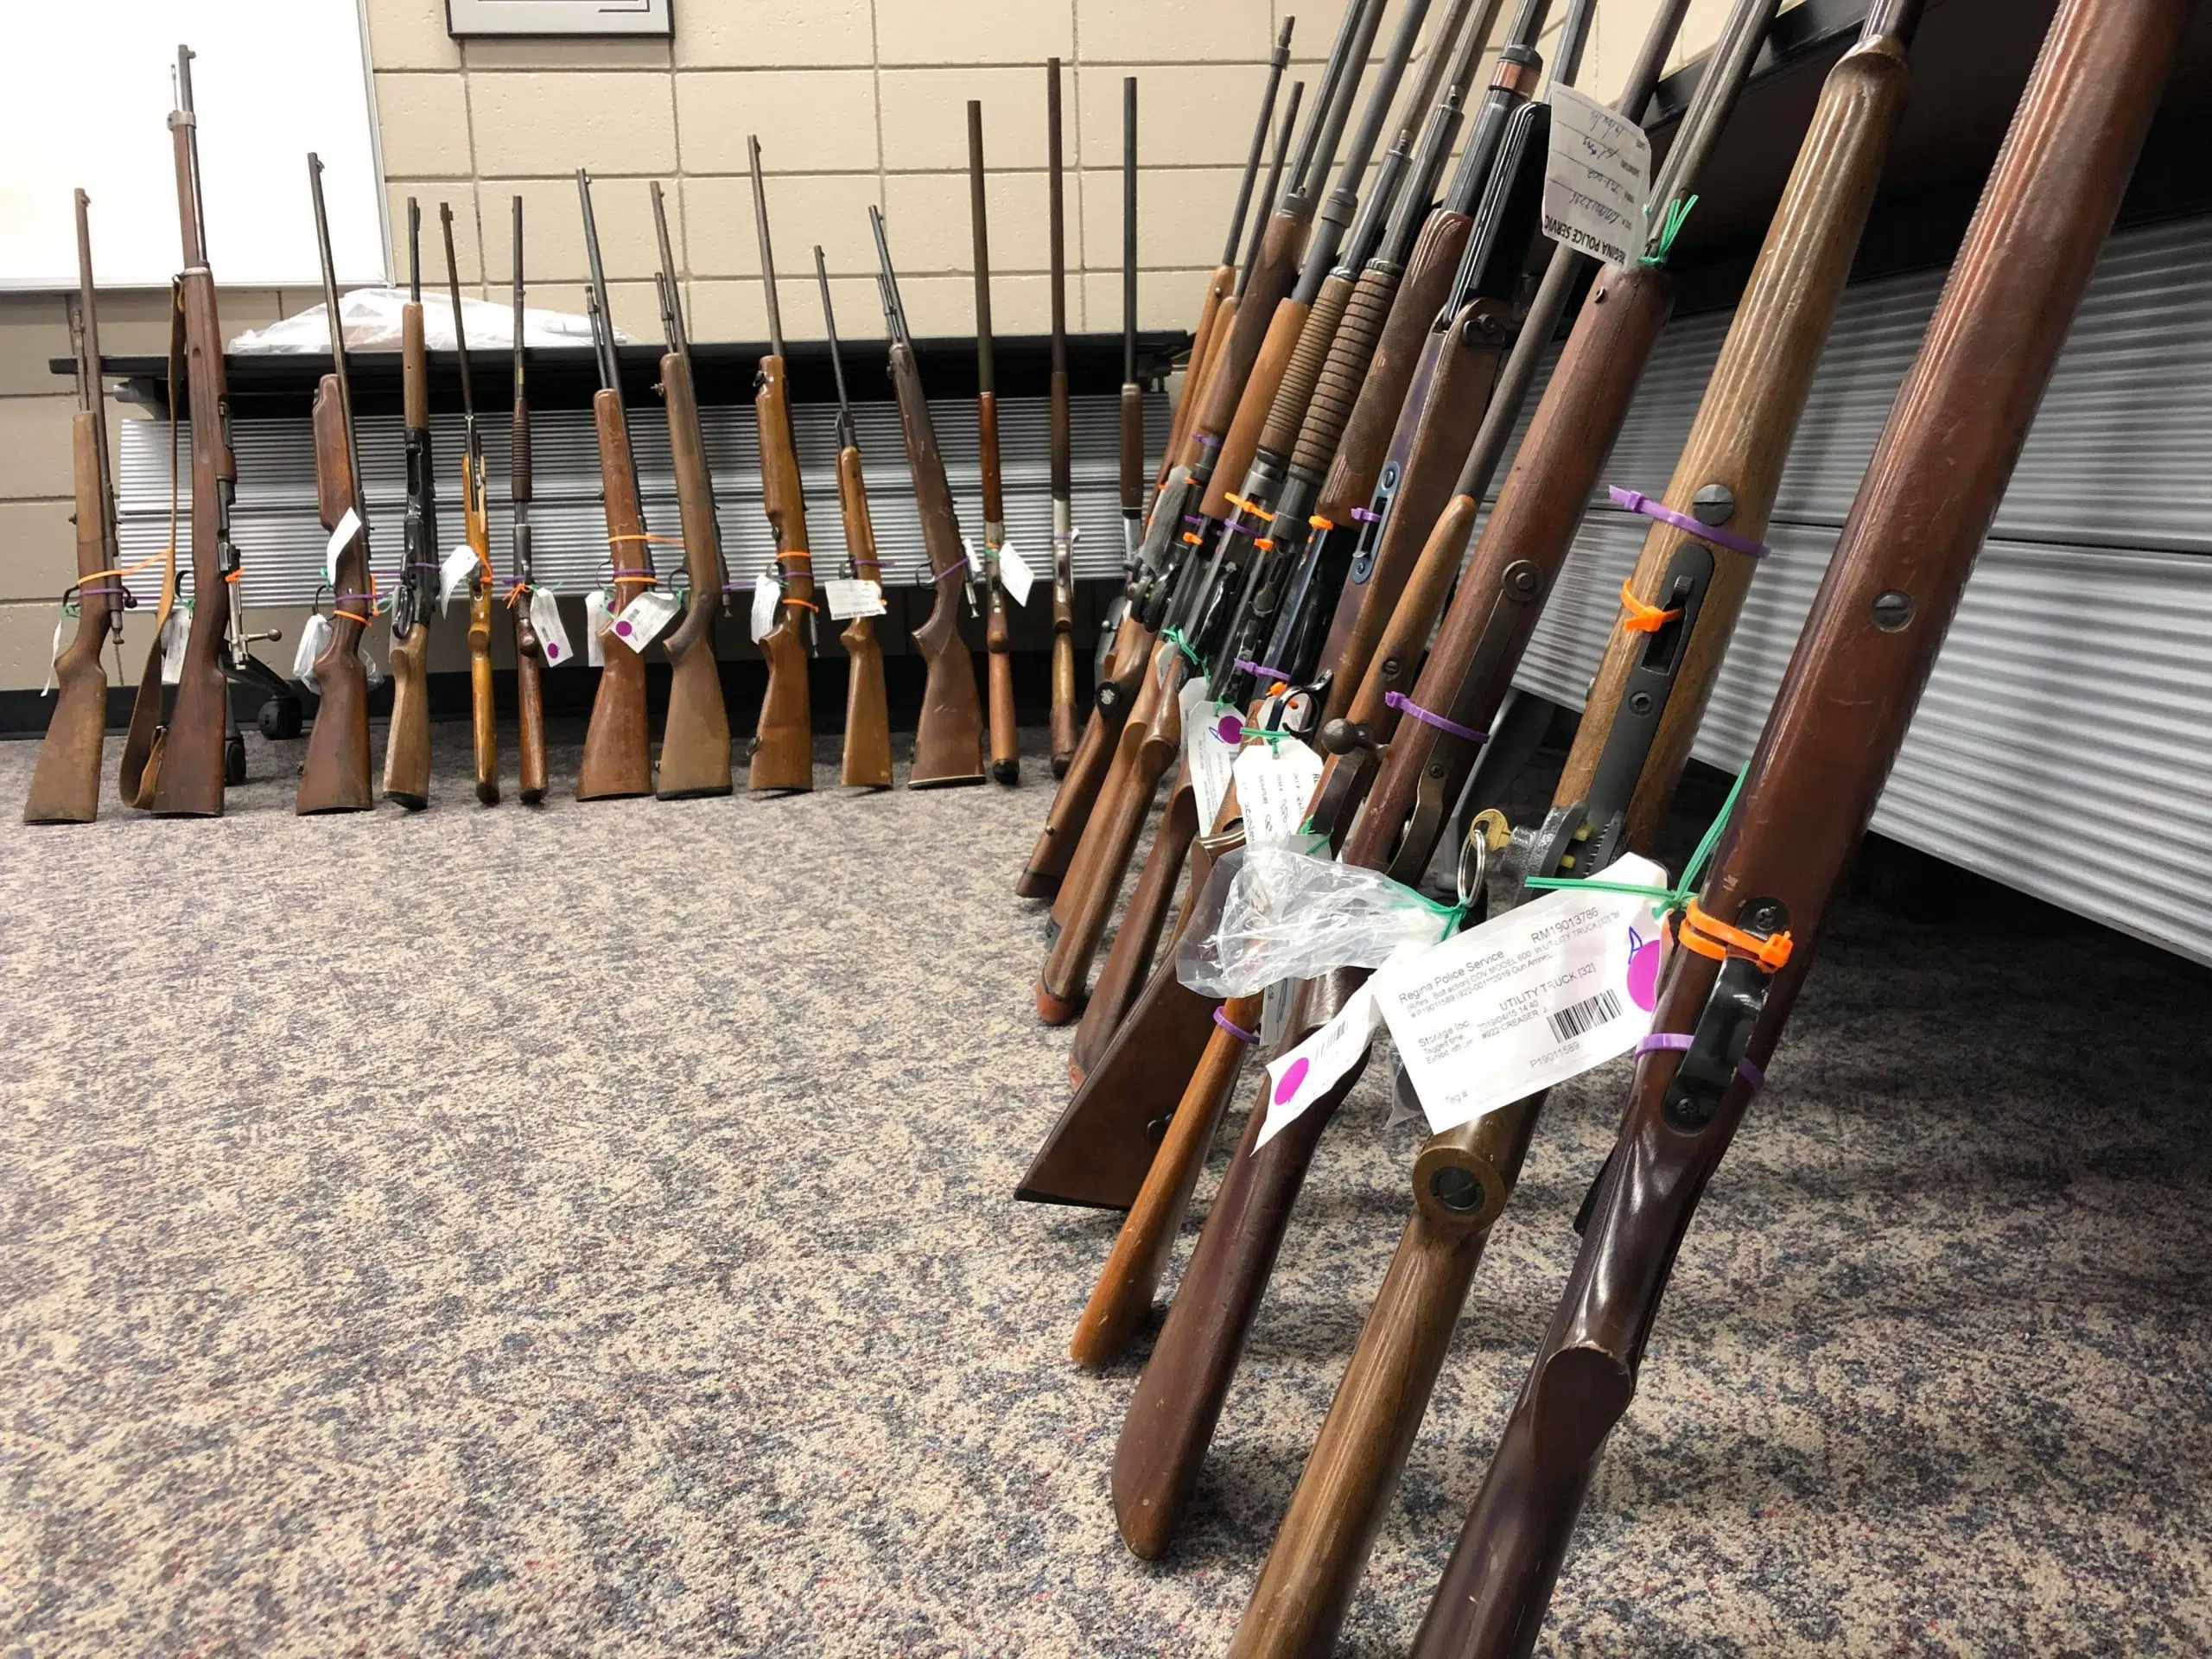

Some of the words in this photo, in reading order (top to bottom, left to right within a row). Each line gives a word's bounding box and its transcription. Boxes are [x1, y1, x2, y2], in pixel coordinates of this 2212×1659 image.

[1543, 214, 1571, 239] SERVIC
[1571, 228, 1600, 252] POLICE
[1530, 906, 1599, 943] RM19013786
[1398, 981, 1433, 1003] Regina
[1433, 966, 1465, 988] Police
[1465, 949, 1504, 972] Service
[1498, 988, 1539, 1011] UTILITY
[1541, 971, 1577, 993] TRUCK
[1576, 962, 1596, 978] [32]
[1418, 1026, 1454, 1046] Storage
[1529, 1040, 1580, 1068] P19011589
